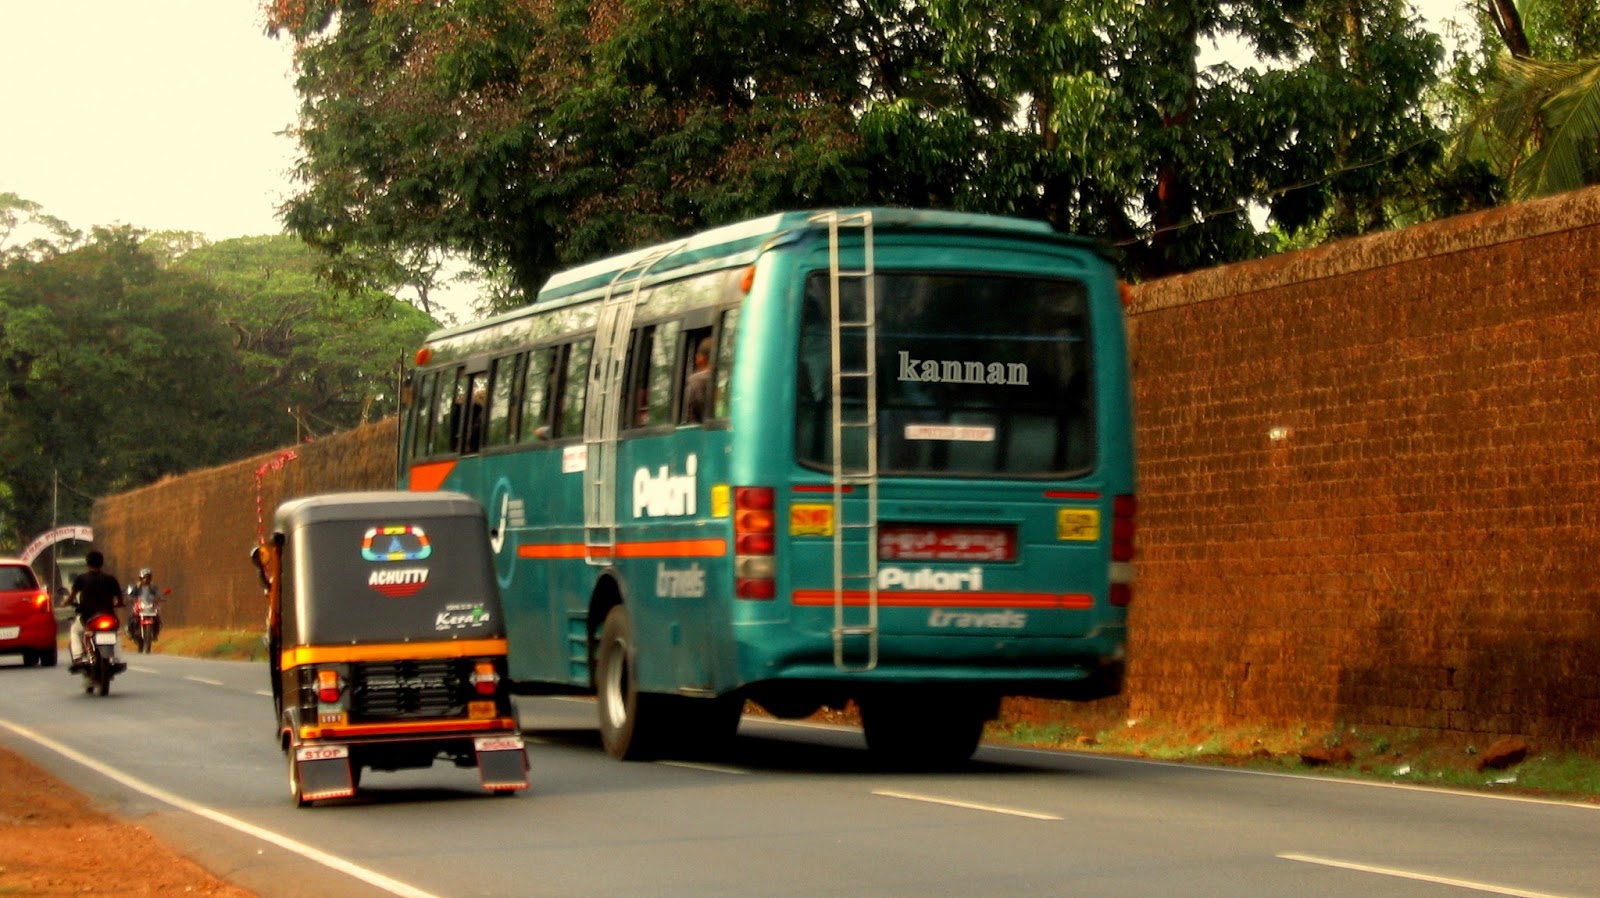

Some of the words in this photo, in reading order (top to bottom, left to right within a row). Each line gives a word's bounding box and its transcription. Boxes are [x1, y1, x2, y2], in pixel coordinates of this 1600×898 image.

[897, 351, 1030, 386] kannan
[633, 453, 698, 518] Pulari
[368, 568, 429, 586] ACHUTTY
[878, 566, 984, 591] Pulari
[927, 607, 1028, 629] travels
[305, 748, 342, 760] STOP
